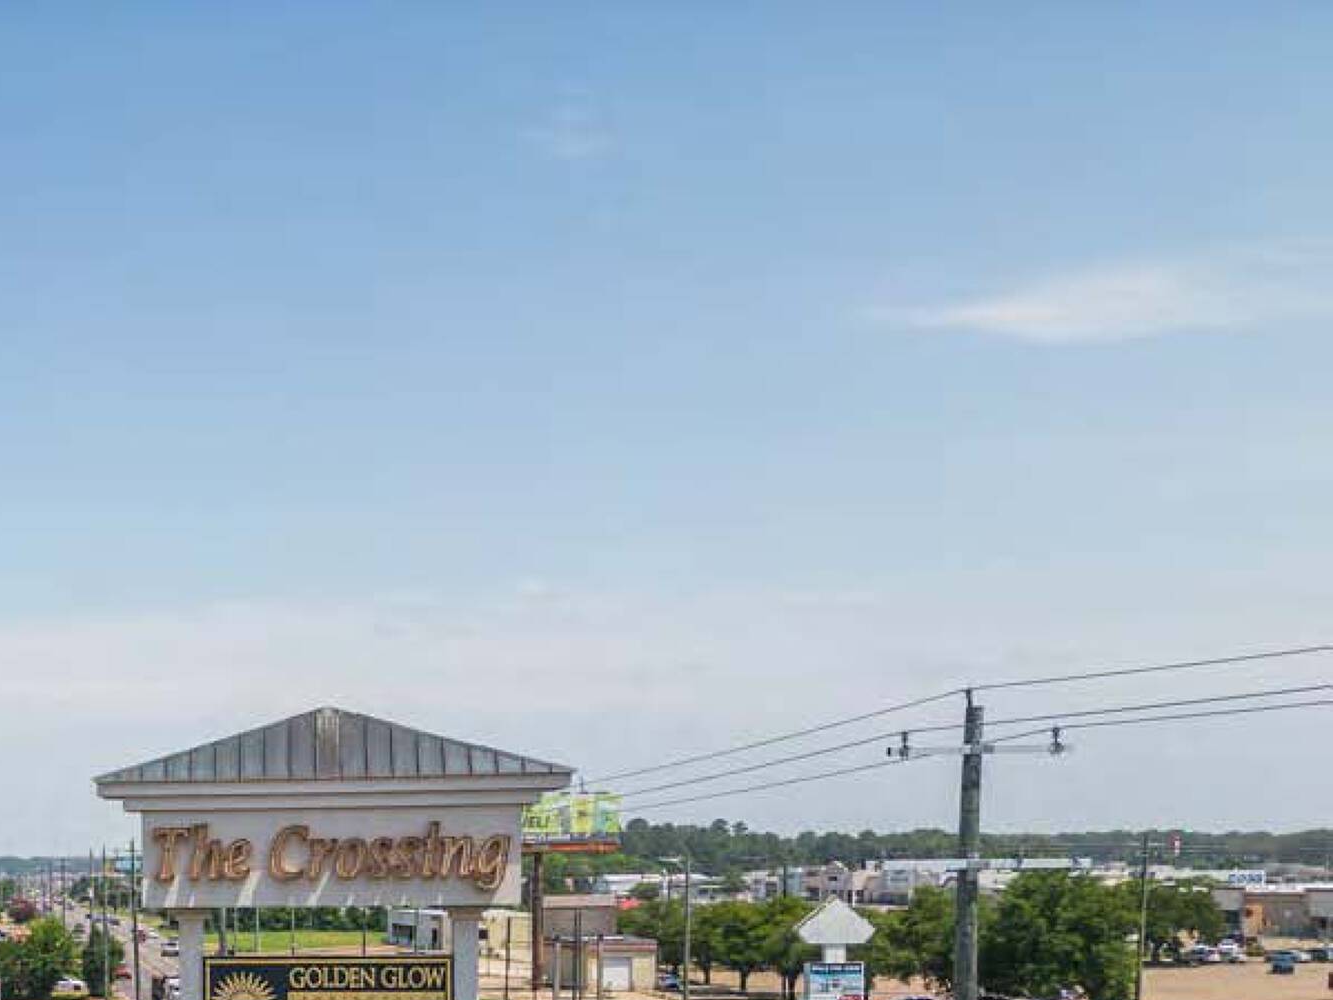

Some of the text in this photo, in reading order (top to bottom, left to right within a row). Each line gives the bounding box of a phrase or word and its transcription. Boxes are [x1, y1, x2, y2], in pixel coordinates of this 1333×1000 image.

[152, 820, 511, 891] The Crossing
[289, 966, 445, 989] GOLDEN GLOW
